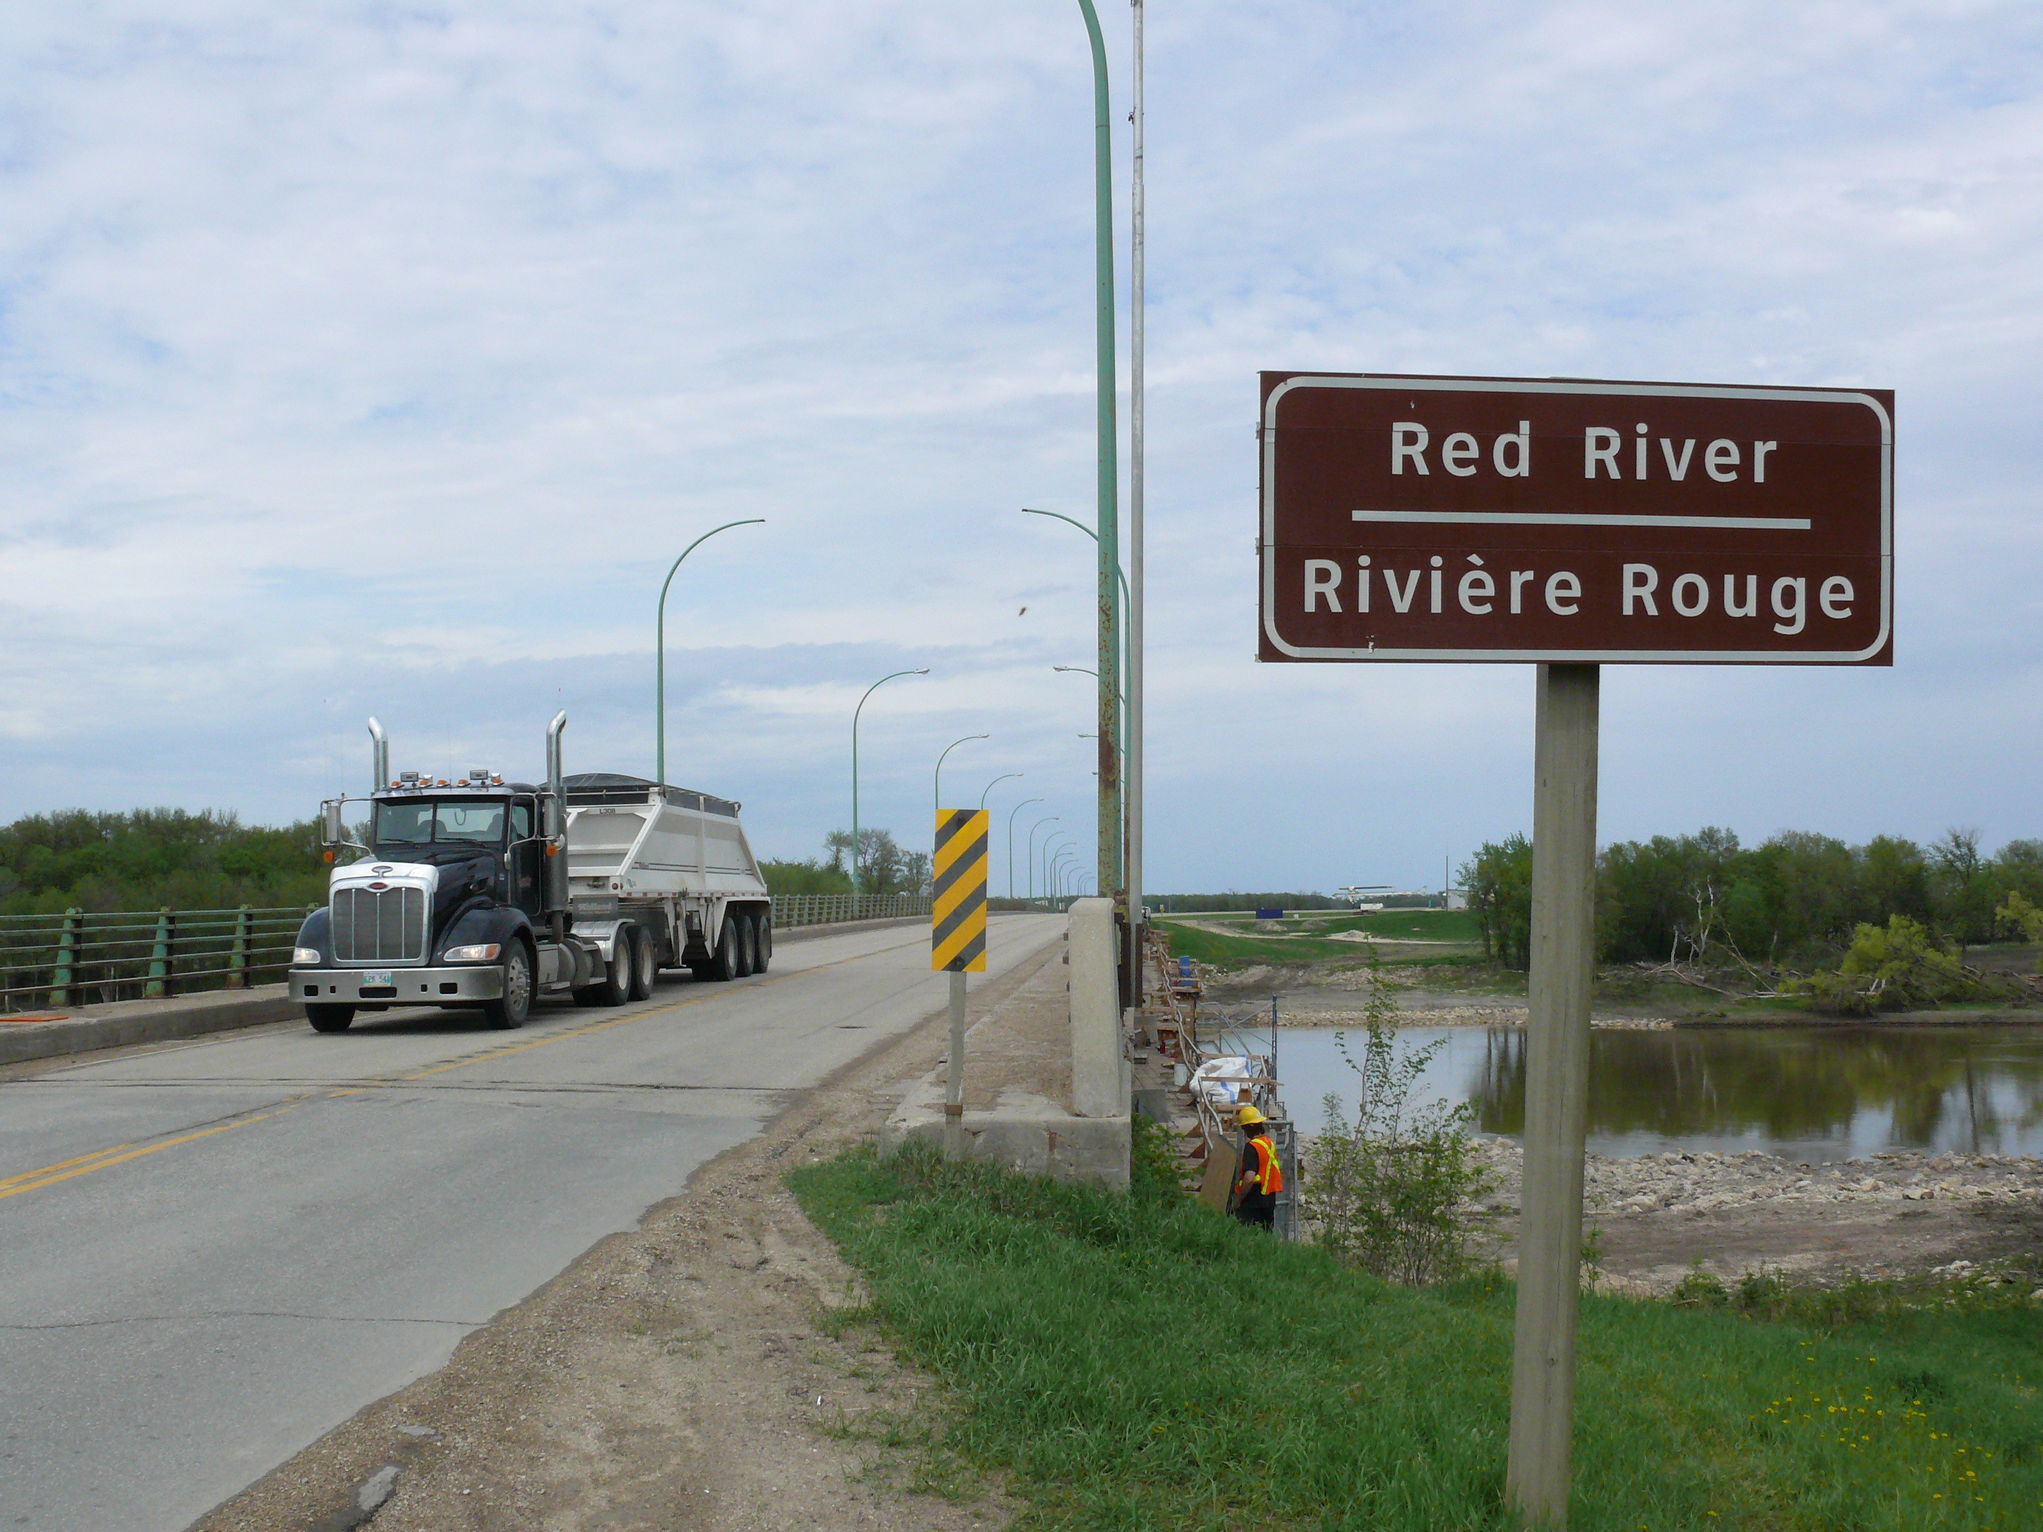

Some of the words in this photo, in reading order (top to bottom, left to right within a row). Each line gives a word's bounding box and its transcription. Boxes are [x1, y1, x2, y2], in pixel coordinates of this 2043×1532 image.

[1391, 421, 1530, 478] Red
[1584, 422, 1777, 483] River
[1304, 553, 1582, 616] Rivière
[1622, 563, 1854, 635] Rouge
